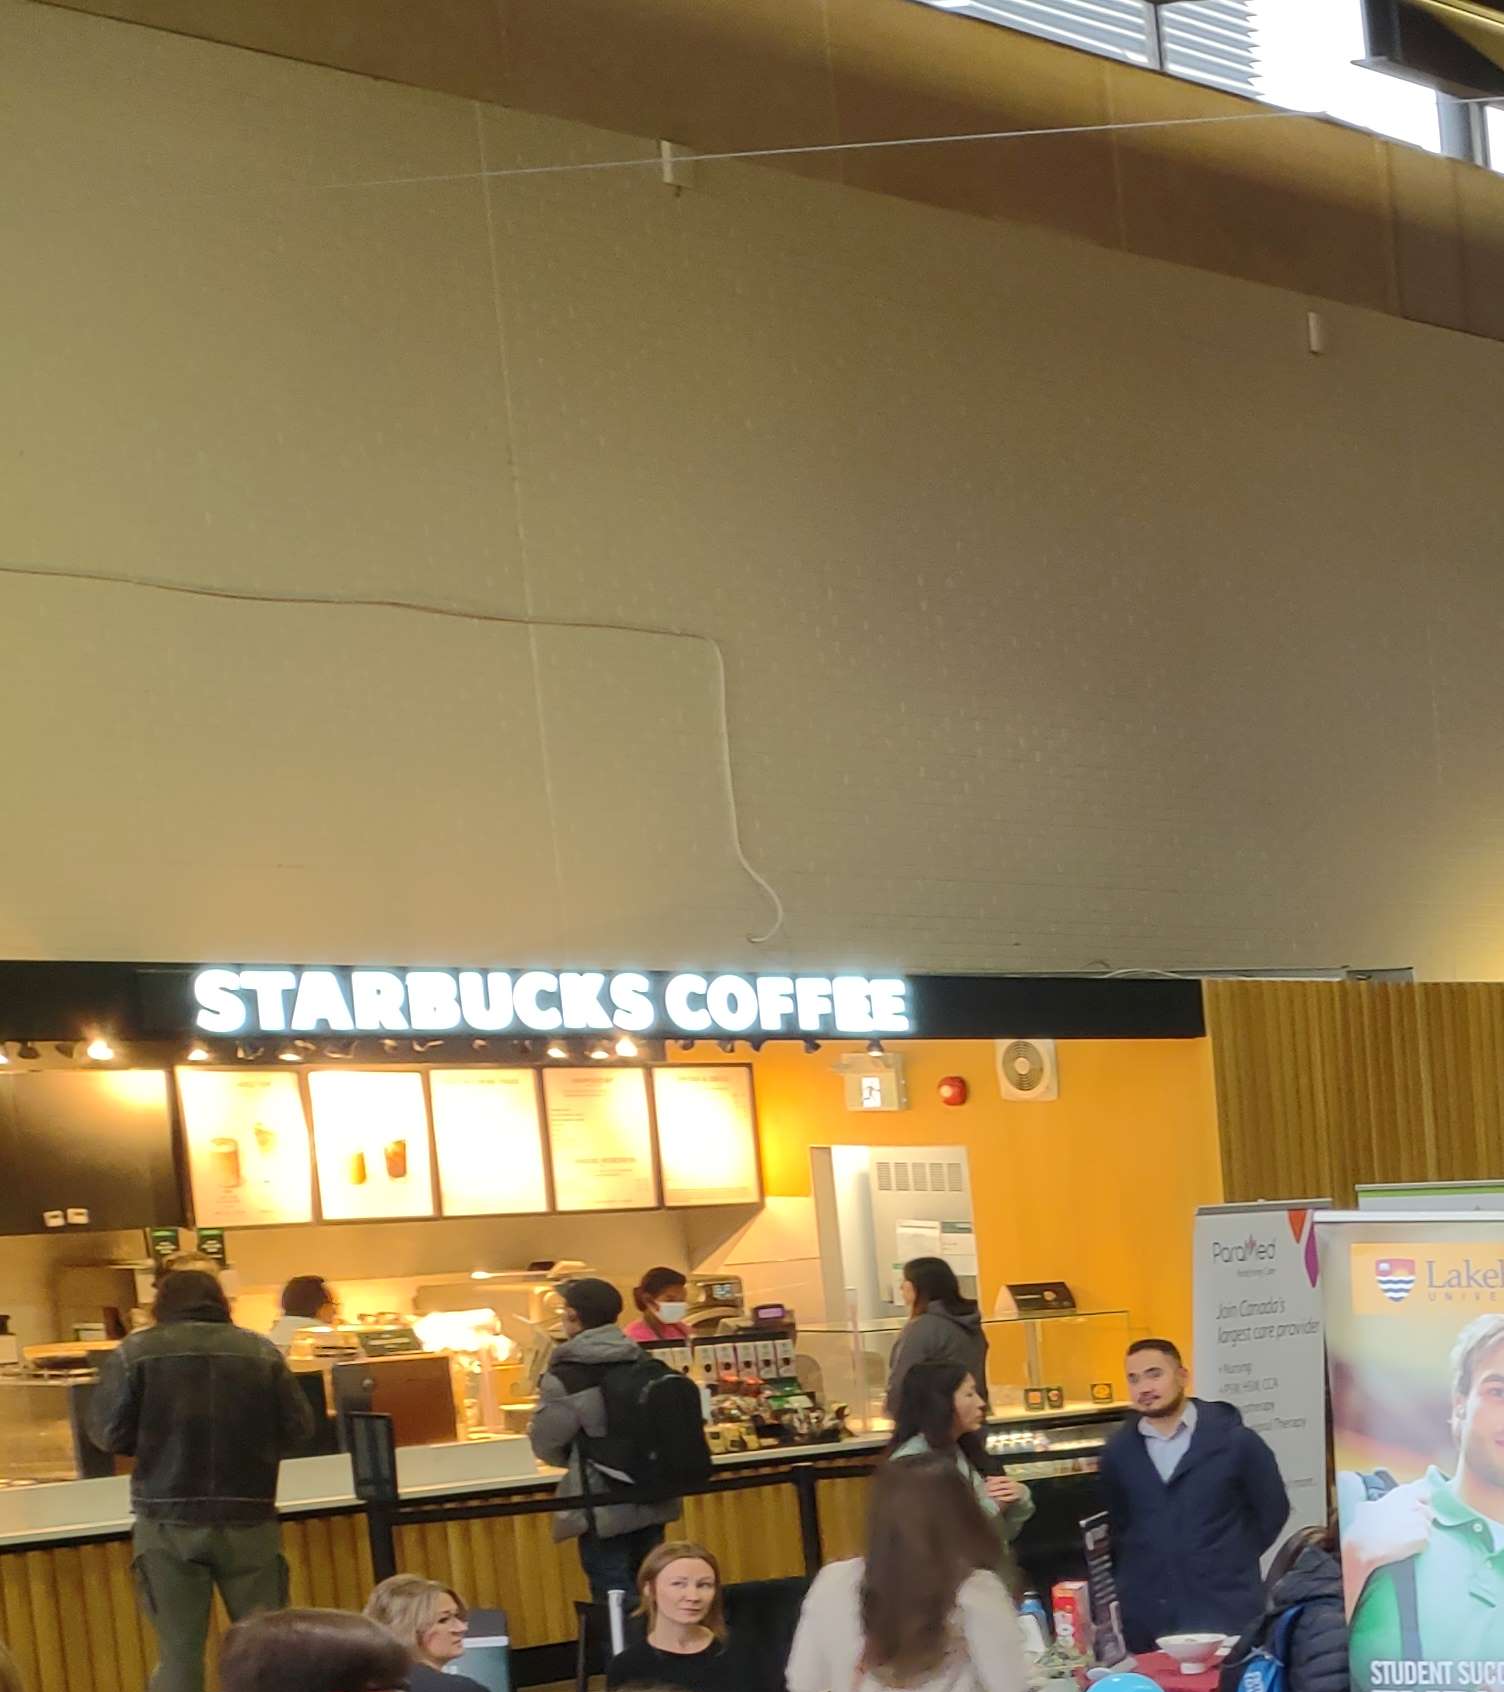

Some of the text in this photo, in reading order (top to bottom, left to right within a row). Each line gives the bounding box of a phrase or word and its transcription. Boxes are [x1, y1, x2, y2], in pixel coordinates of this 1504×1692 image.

[194, 967, 911, 1036] STARBUCKS COFFEE
[1370, 1660, 1453, 1685] STUDENT
